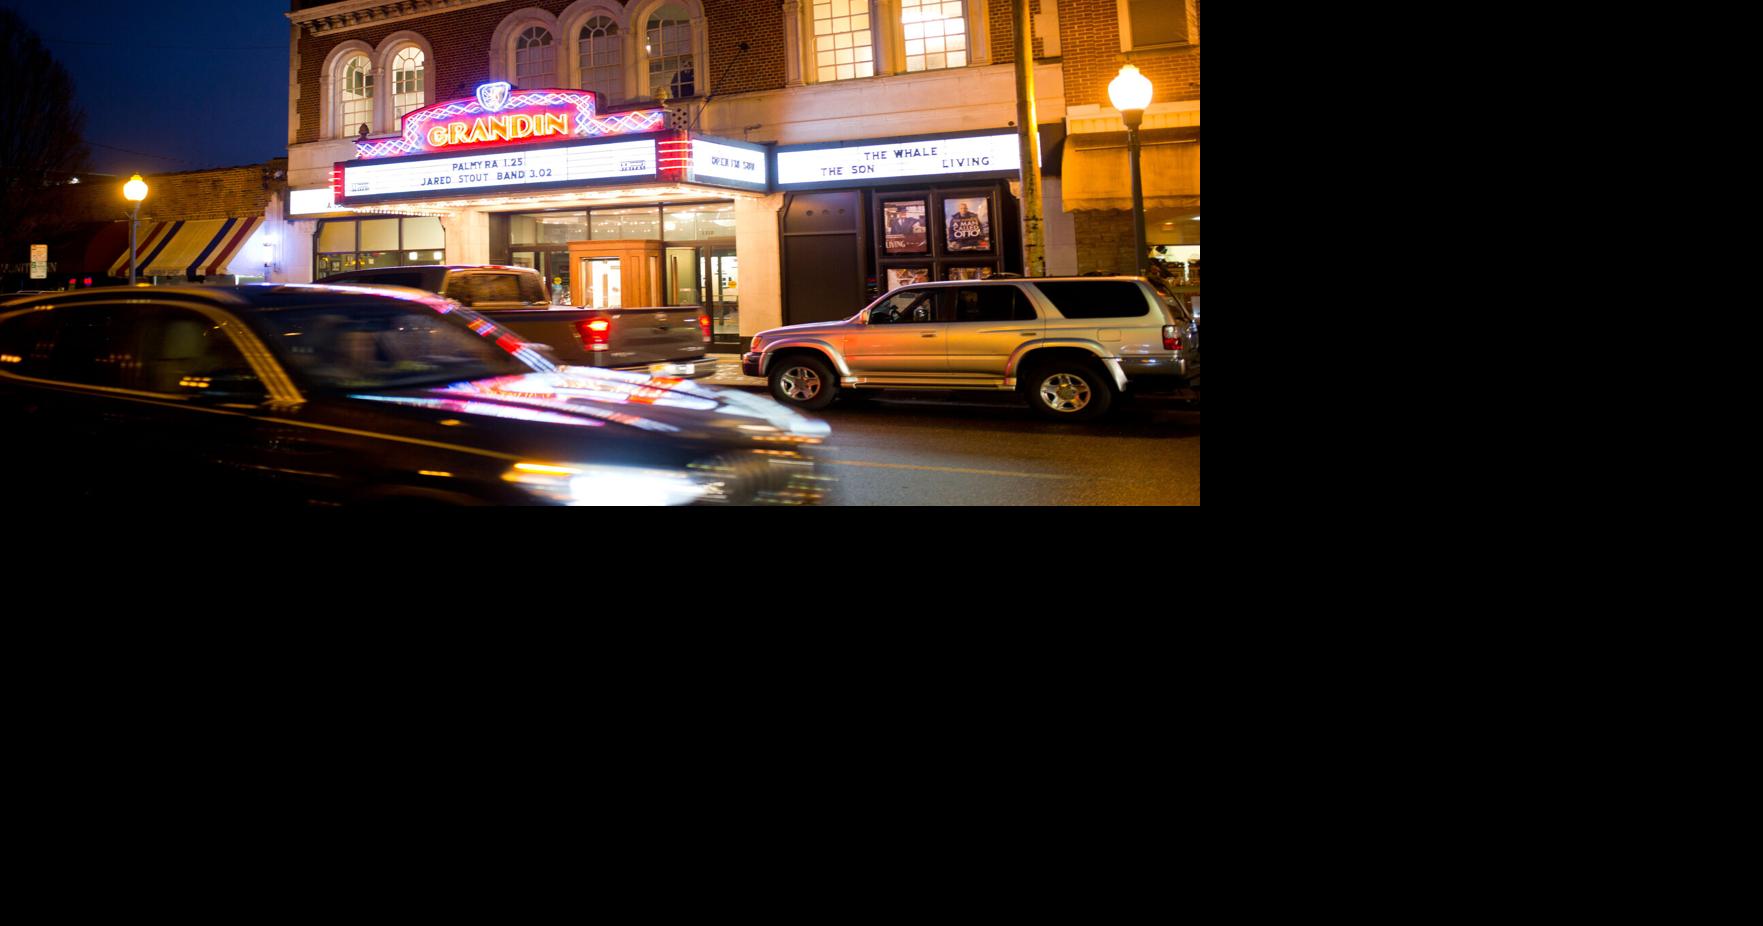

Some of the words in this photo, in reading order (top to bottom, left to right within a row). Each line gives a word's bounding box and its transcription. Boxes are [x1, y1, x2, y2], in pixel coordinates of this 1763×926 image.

[427, 112, 569, 147] GRANDIN
[864, 151, 888, 160] THE
[893, 147, 938, 159] WHALE
[503, 157, 524, 167] 1.25
[942, 157, 990, 168] LIVING
[820, 167, 843, 176] THE
[851, 165, 875, 174] SON
[420, 176, 452, 186] JARED
[458, 173, 489, 183] STOUT
[496, 170, 526, 181] BAND
[529, 168, 553, 178] 3.02
